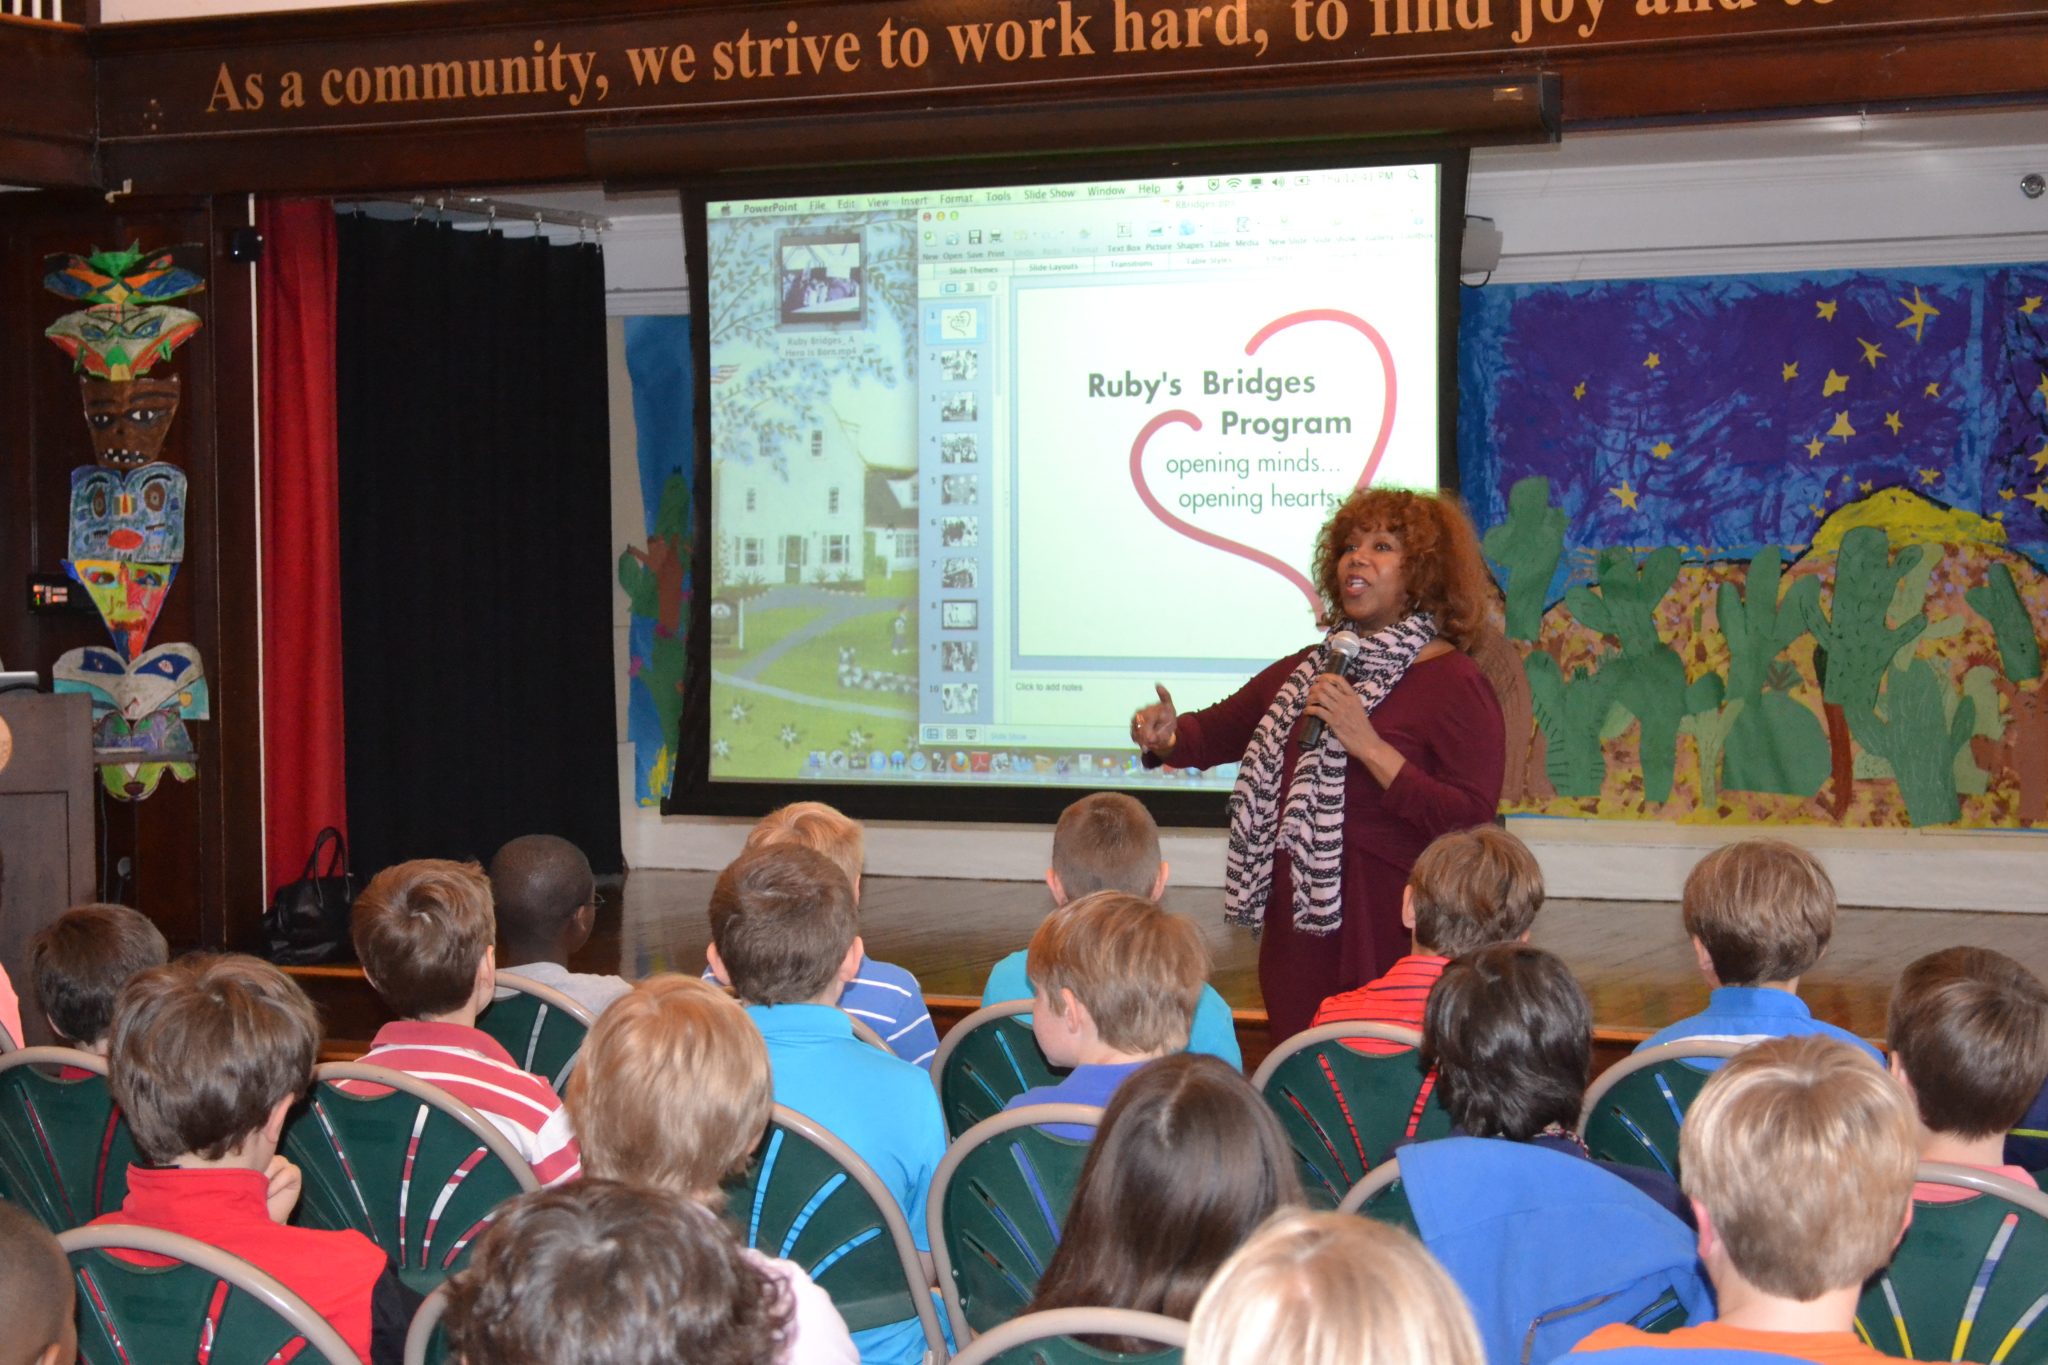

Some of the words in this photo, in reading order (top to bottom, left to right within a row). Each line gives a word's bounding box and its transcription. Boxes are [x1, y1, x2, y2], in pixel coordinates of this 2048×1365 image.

[206, 61, 265, 113] As
[280, 71, 306, 108] a
[320, 38, 609, 106] community,
[625, 41, 697, 85] we
[713, 20, 861, 81] strive
[877, 16, 930, 69] to
[946, 1, 1095, 64] work
[1113, 0, 1270, 57] hard,
[1295, 0, 1349, 42] to
[743, 202, 798, 214] PowerPoint
[809, 200, 826, 211] File
[837, 198, 856, 209] Edit
[867, 197, 890, 208] View
[901, 195, 928, 206] Insert
[940, 193, 974, 205] Format
[986, 191, 1012, 202] Tools
[1024, 189, 1047, 200] Slide
[1050, 187, 1075, 198] Show
[1088, 185, 1127, 197] Window
[1138, 183, 1161, 195] Help
[1089, 371, 1182, 404] Ruby's
[1203, 367, 1316, 401] Bridges
[1222, 410, 1352, 442] Program
[1166, 452, 1250, 480] opening
[1258, 448, 1340, 473] minds...
[1179, 486, 1263, 514] opening
[1015, 683, 1034, 692] Click
[1046, 682, 1059, 692] add
[1062, 682, 1083, 692] notes
